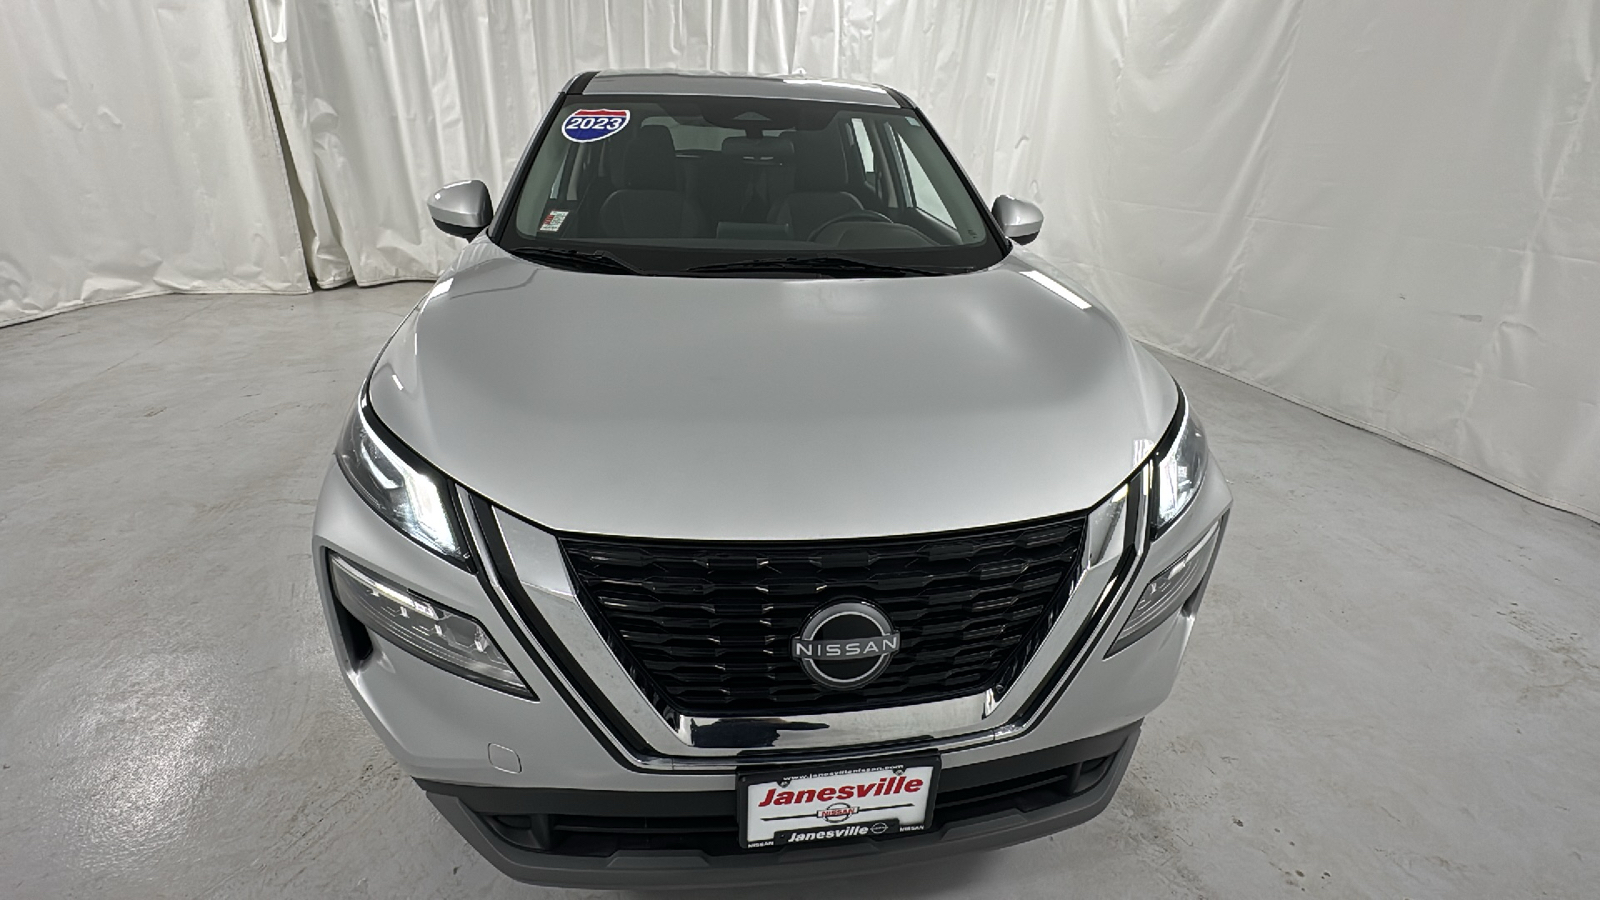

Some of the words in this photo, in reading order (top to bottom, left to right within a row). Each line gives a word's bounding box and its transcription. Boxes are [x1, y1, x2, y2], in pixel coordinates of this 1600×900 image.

[566, 118, 622, 130] 2023
[796, 637, 897, 656] NISSAN
[758, 776, 923, 807] Janesville
[821, 808, 854, 817] NISSAN
[788, 825, 869, 842] Janesville
